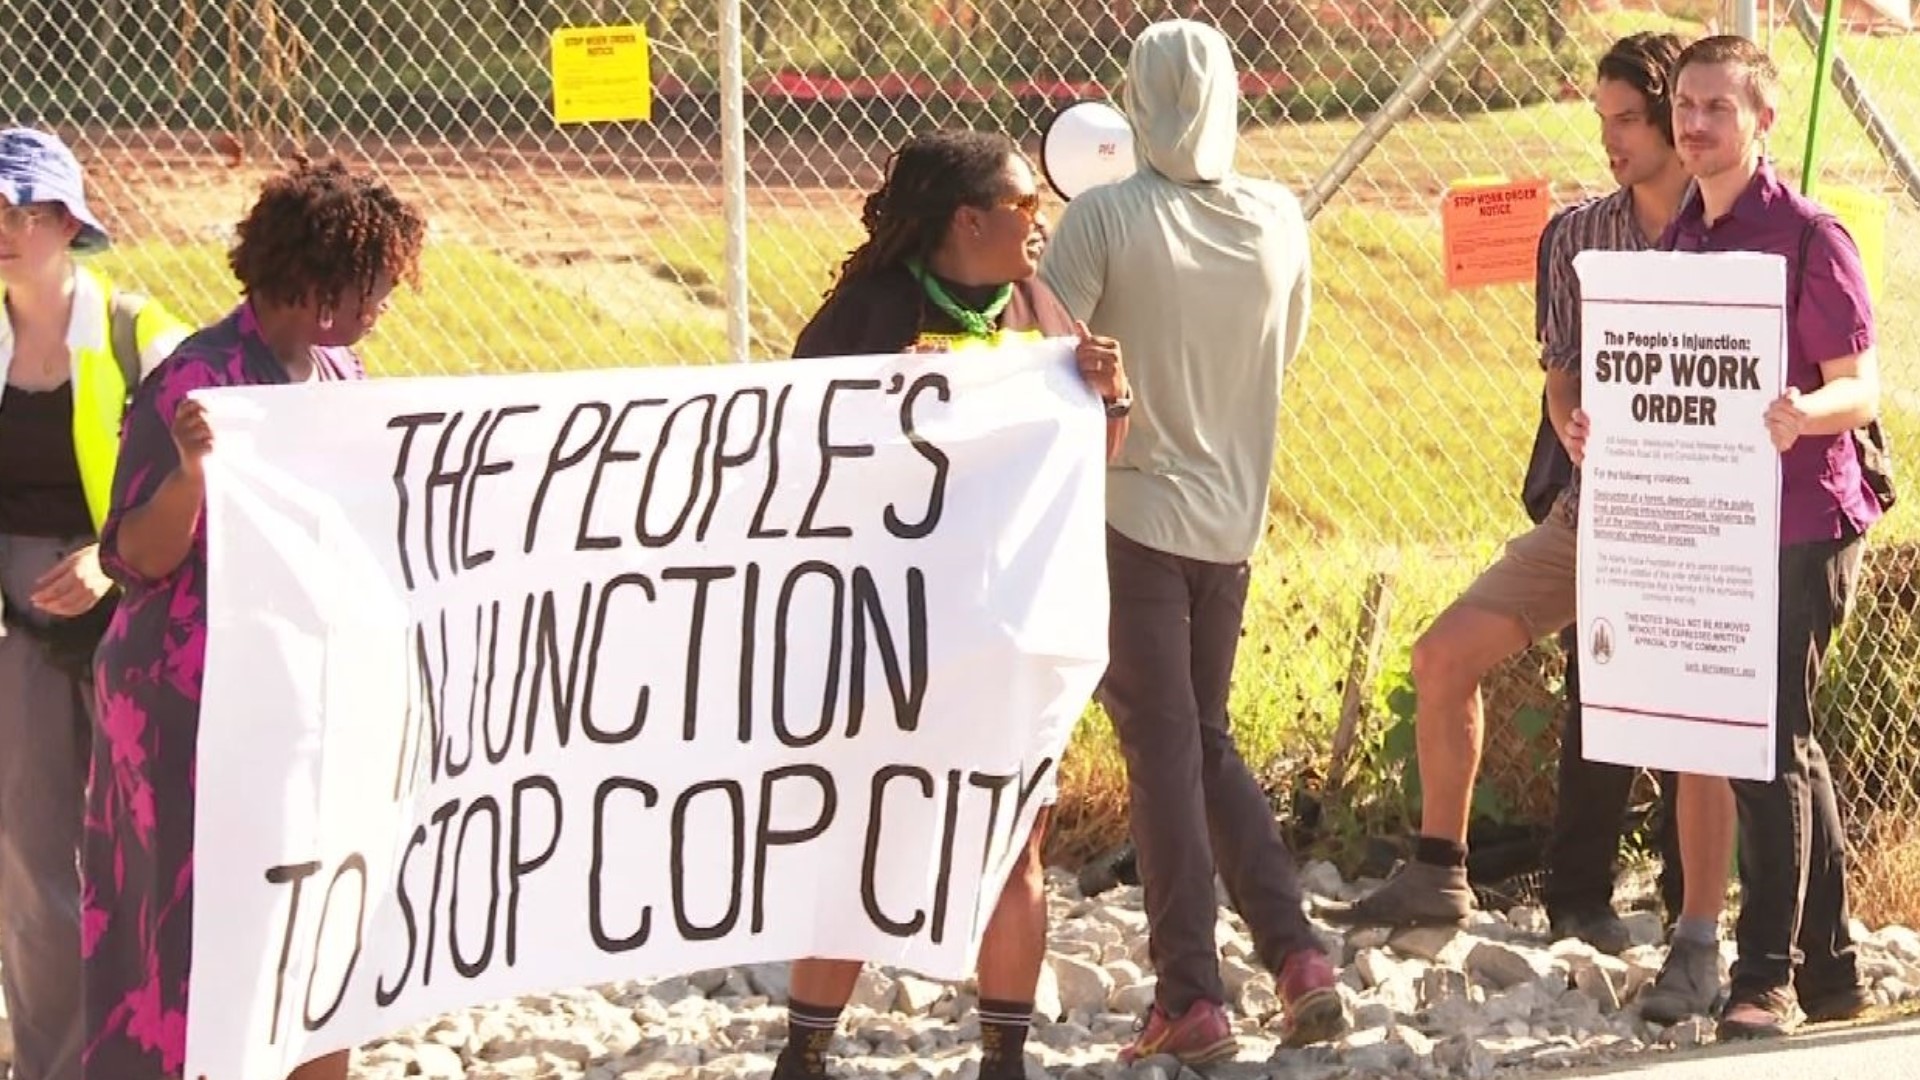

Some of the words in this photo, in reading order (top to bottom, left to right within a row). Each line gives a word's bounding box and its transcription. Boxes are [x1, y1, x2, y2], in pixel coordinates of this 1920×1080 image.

[1454, 196, 1475, 208] STOP
[1477, 191, 1503, 205] WORK
[1604, 331, 1624, 346] The
[1627, 331, 1679, 349] People's
[1681, 334, 1752, 351] Injunction:
[1595, 350, 1663, 386] STOP
[1670, 353, 1761, 390] WORK
[1631, 393, 1717, 427] ORDER
[387, 402, 541, 591] THE
[524, 372, 951, 555] PEOPLE'S
[394, 559, 929, 801] INJUNCTION
[265, 851, 367, 1045] TO
[375, 773, 563, 1008] STOP
[587, 762, 838, 954] COP
[859, 757, 1053, 945] CITY
